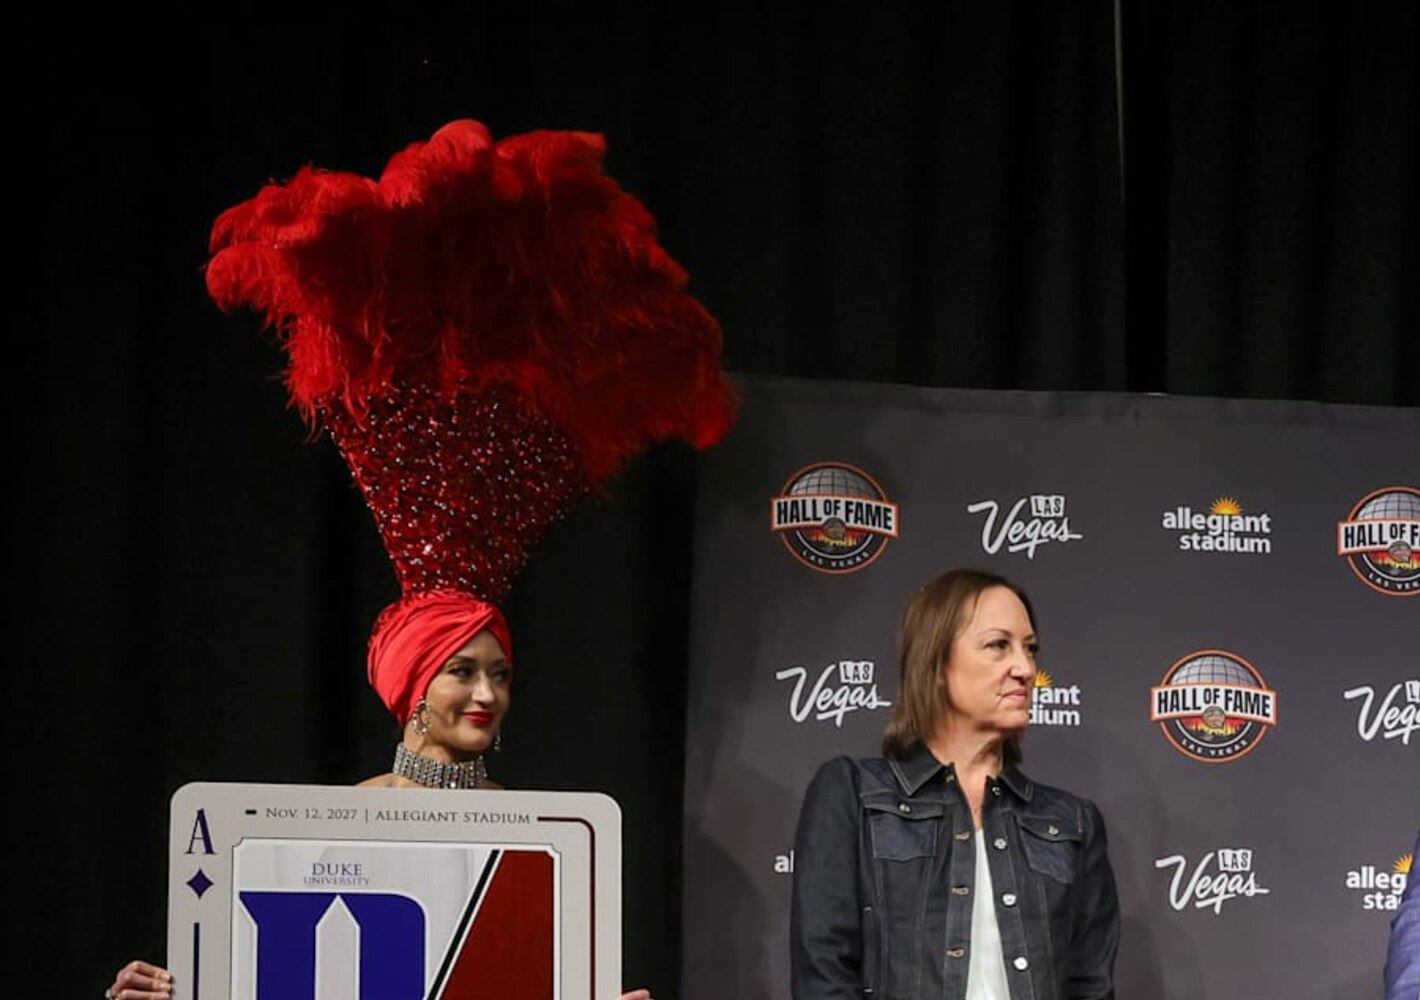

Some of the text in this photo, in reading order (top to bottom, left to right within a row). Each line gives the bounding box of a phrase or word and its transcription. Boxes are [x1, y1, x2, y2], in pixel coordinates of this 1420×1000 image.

[777, 499, 891, 531] HALL OF FAME
[1032, 497, 1064, 516] LAS
[967, 498, 1083, 558] Vegas
[1162, 507, 1271, 536] allegiant
[1179, 532, 1271, 553] stadium
[1344, 523, 1388, 549] HALL
[1389, 523, 1407, 540] OF
[840, 662, 873, 683] LAS
[776, 664, 892, 726] Vegas
[1158, 688, 1270, 718] HALL OF FAME
[327, 809, 358, 820] 2027
[375, 810, 459, 823] ALLEGIANT
[462, 811, 530, 825] STADIUM
[185, 808, 218, 855] A
[311, 863, 363, 876] DUKE
[1219, 850, 1251, 871] LAS
[303, 876, 371, 886] UNIVERSITY
[1155, 852, 1270, 913] Vegas
